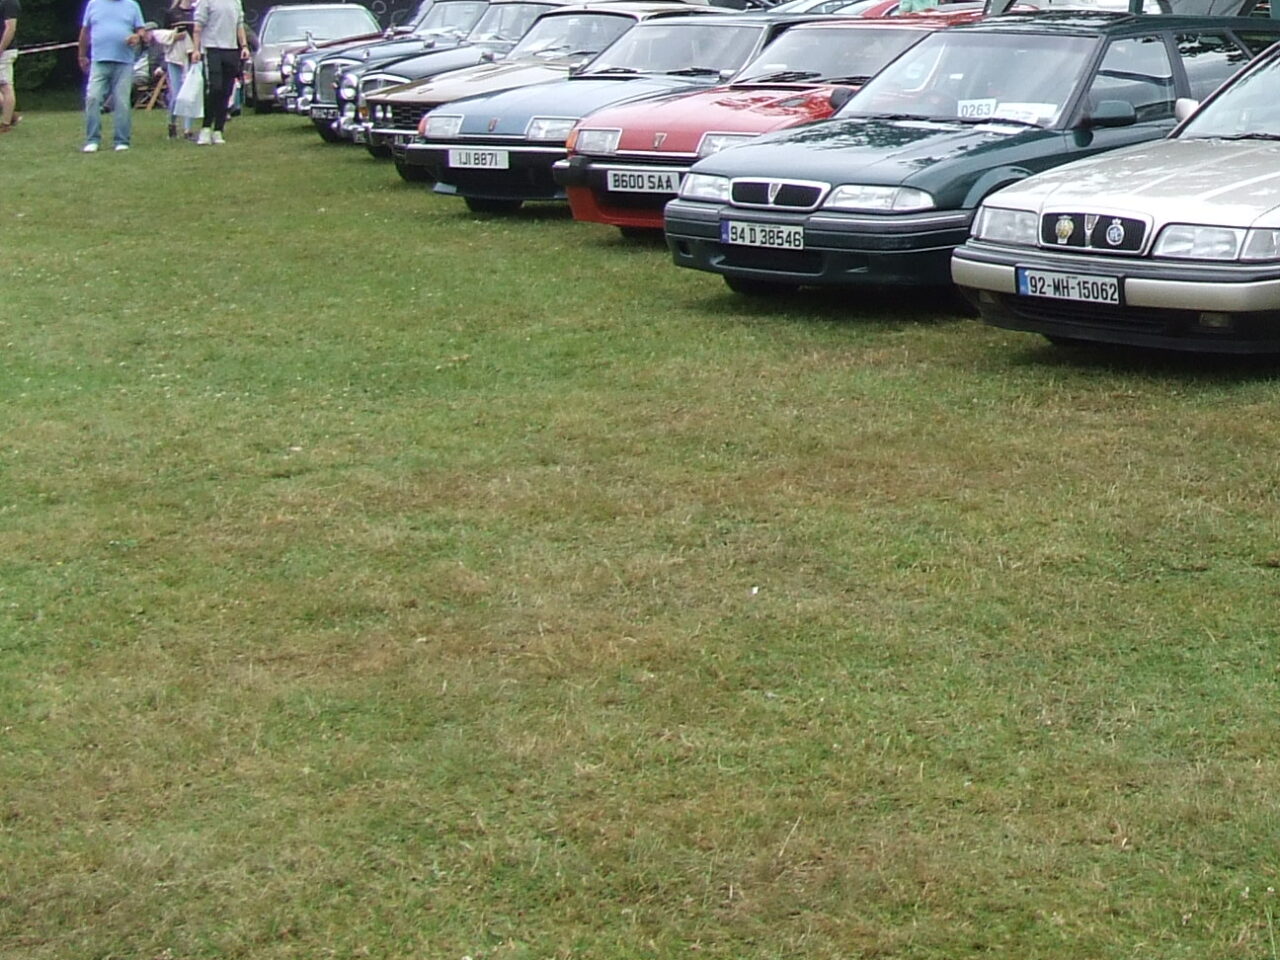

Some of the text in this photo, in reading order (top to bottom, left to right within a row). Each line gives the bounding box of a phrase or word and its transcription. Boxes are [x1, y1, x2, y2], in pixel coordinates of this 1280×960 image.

[961, 103, 991, 117] 0263
[473, 152, 498, 166] 8871
[613, 173, 673, 191] B600 SAA
[730, 226, 745, 243] 94
[749, 227, 757, 244] D
[760, 229, 802, 248] 38546
[1029, 275, 1118, 302] 92-MH-15062
